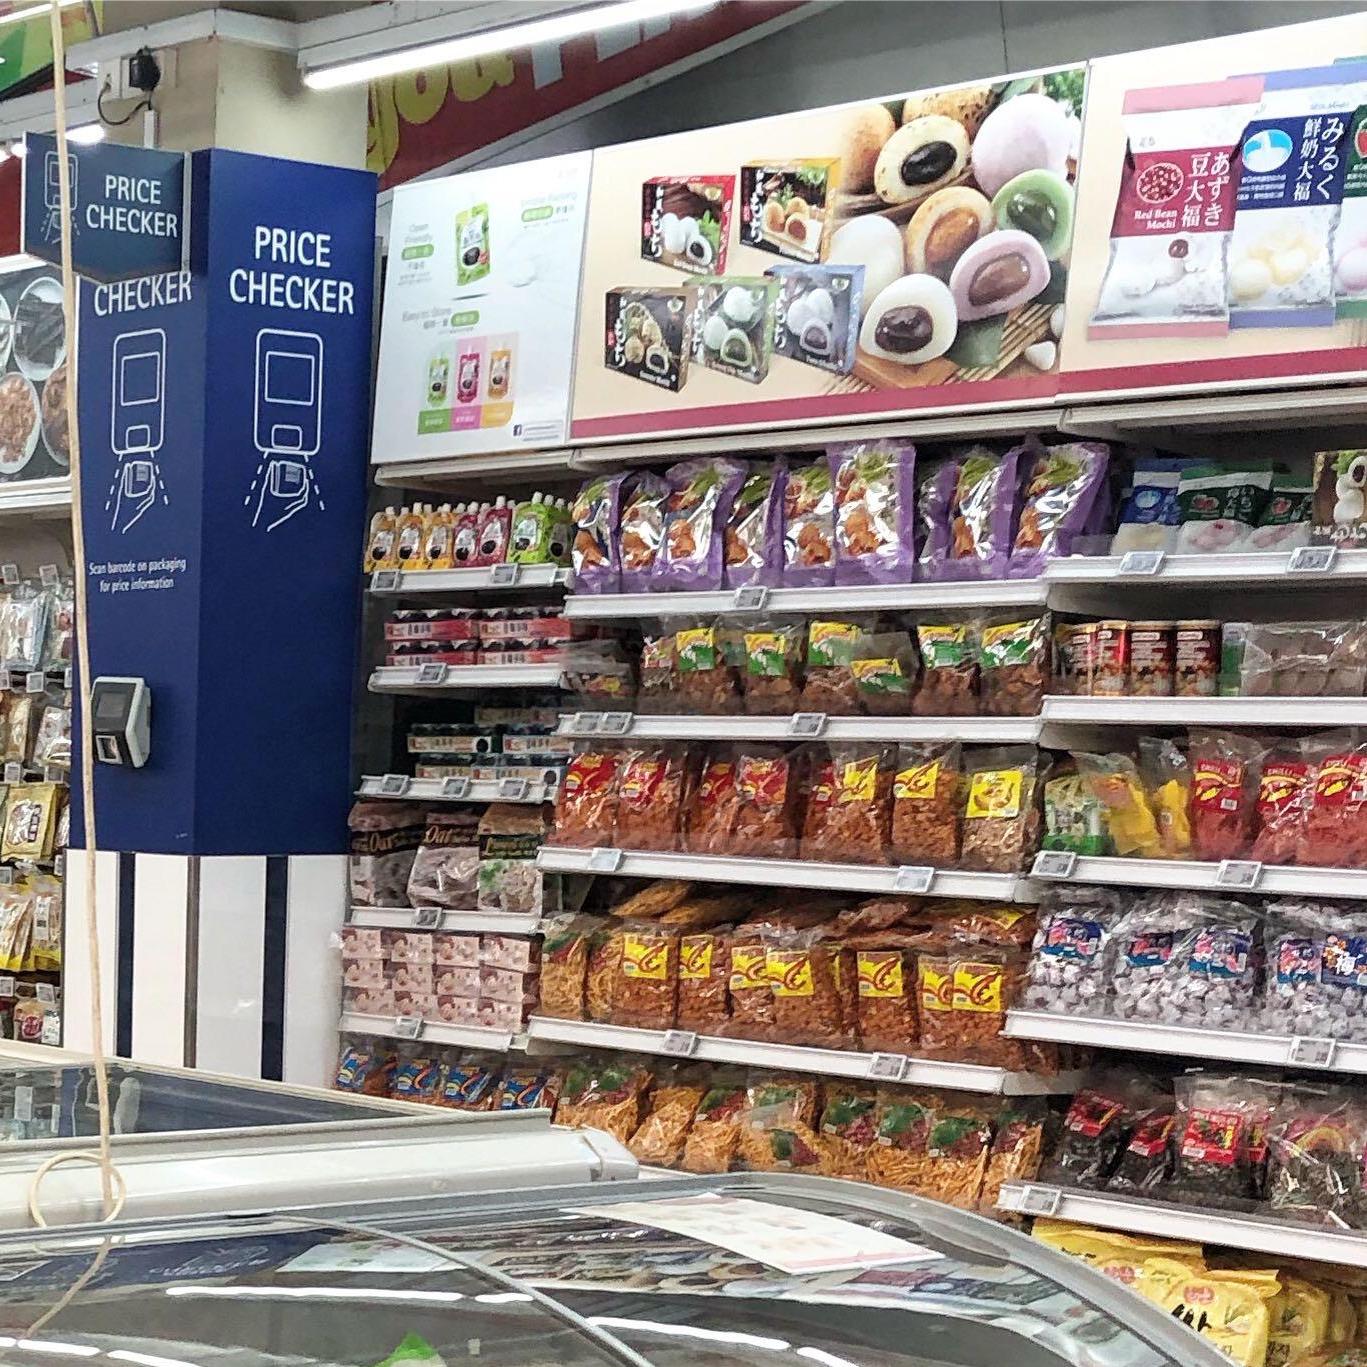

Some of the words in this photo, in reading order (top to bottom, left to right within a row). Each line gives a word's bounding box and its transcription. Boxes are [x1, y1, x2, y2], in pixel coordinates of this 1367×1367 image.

[1293, 116, 1323, 201] 鮮奶大福
[1317, 117, 1345, 200] みるく
[105, 174, 162, 205] PRICE
[1181, 152, 1212, 228] 豆大福
[1204, 151, 1231, 227] あずき
[85, 203, 178, 238] CHECKER
[1134, 209, 1153, 220] Red
[1154, 208, 1179, 219] Bean
[1146, 218, 1176, 230] Mochi
[254, 225, 332, 268] PRICE
[93, 271, 193, 317] CHECKER
[228, 268, 355, 315] CHECKER
[89, 561, 107, 575] Scan
[107, 560, 136, 574] barcode
[137, 562, 147, 572] on
[148, 557, 187, 574] packaging
[99, 580, 110, 593] for
[111, 579, 130, 595] price
[131, 576, 174, 590] information
